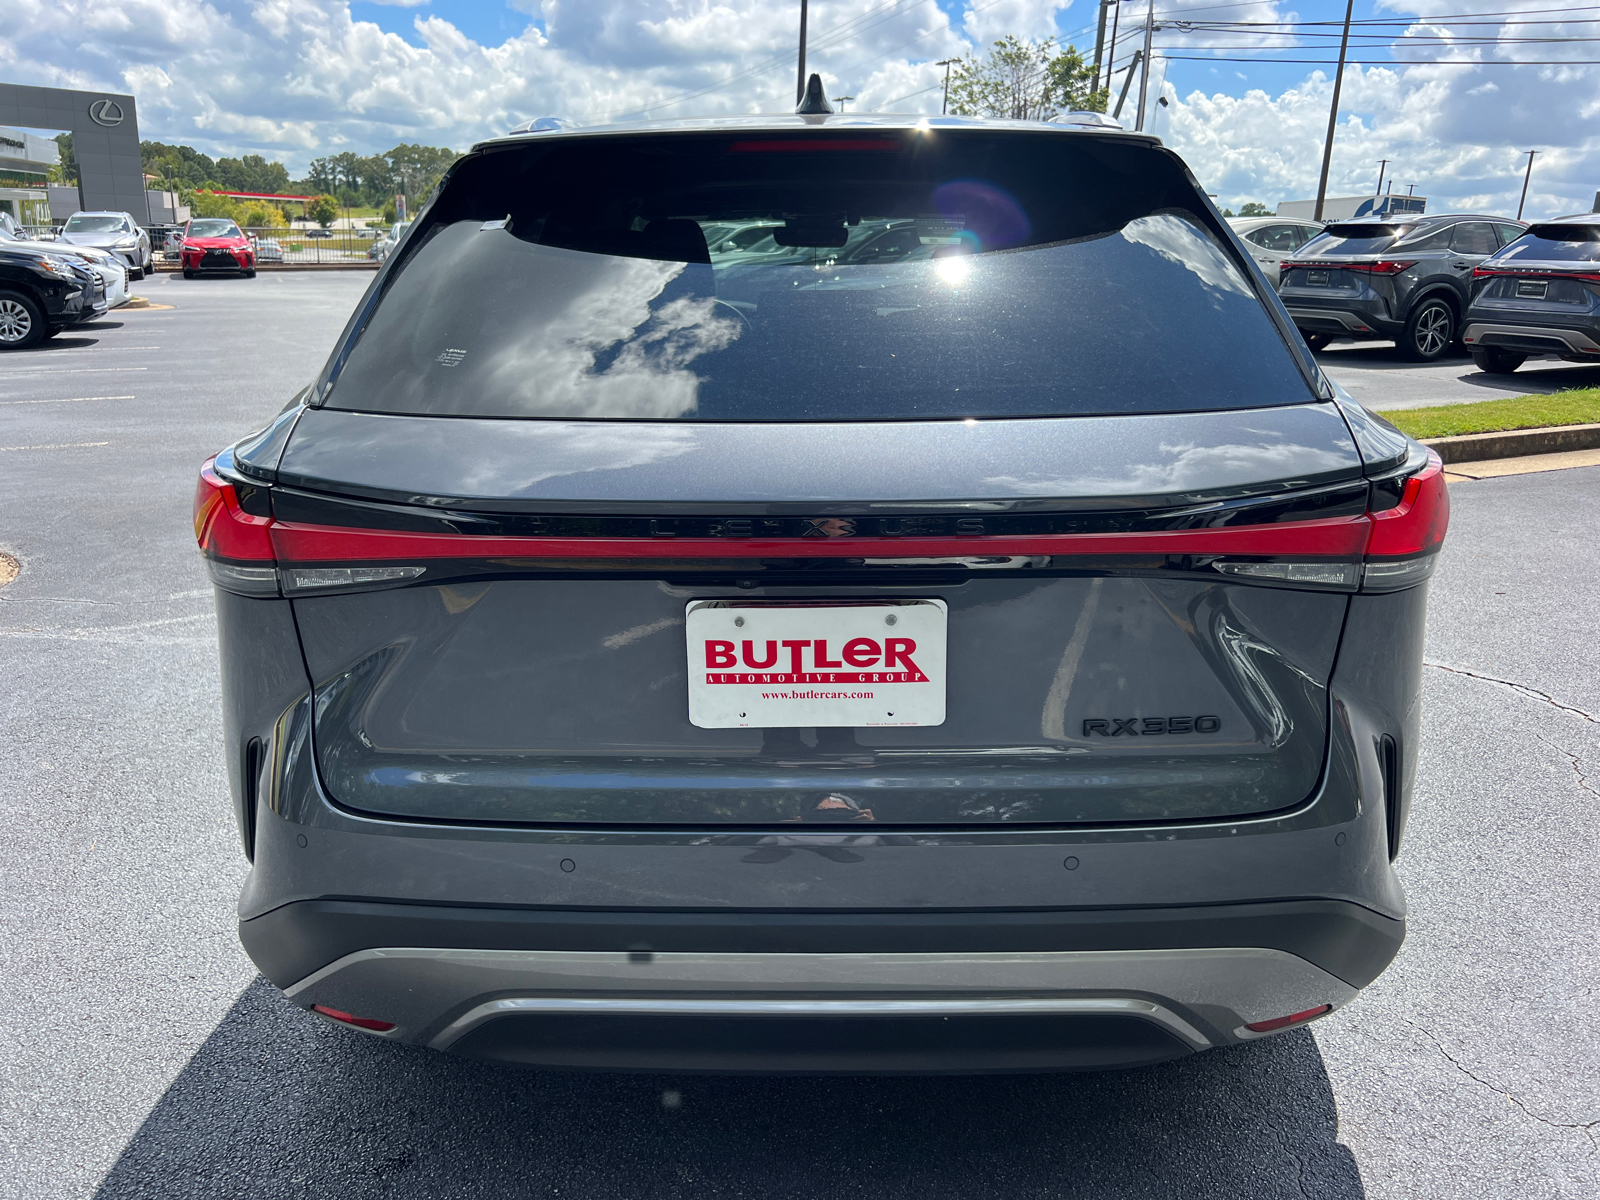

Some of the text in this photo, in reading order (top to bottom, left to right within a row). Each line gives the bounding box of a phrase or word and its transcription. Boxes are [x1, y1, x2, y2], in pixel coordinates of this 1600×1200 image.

[650, 518, 985, 537] LEXUS
[707, 672, 921, 683] AUTOMOTIVE GROUP
[761, 690, 874, 700] www.butlercars.com
[1083, 715, 1222, 737] RX350
